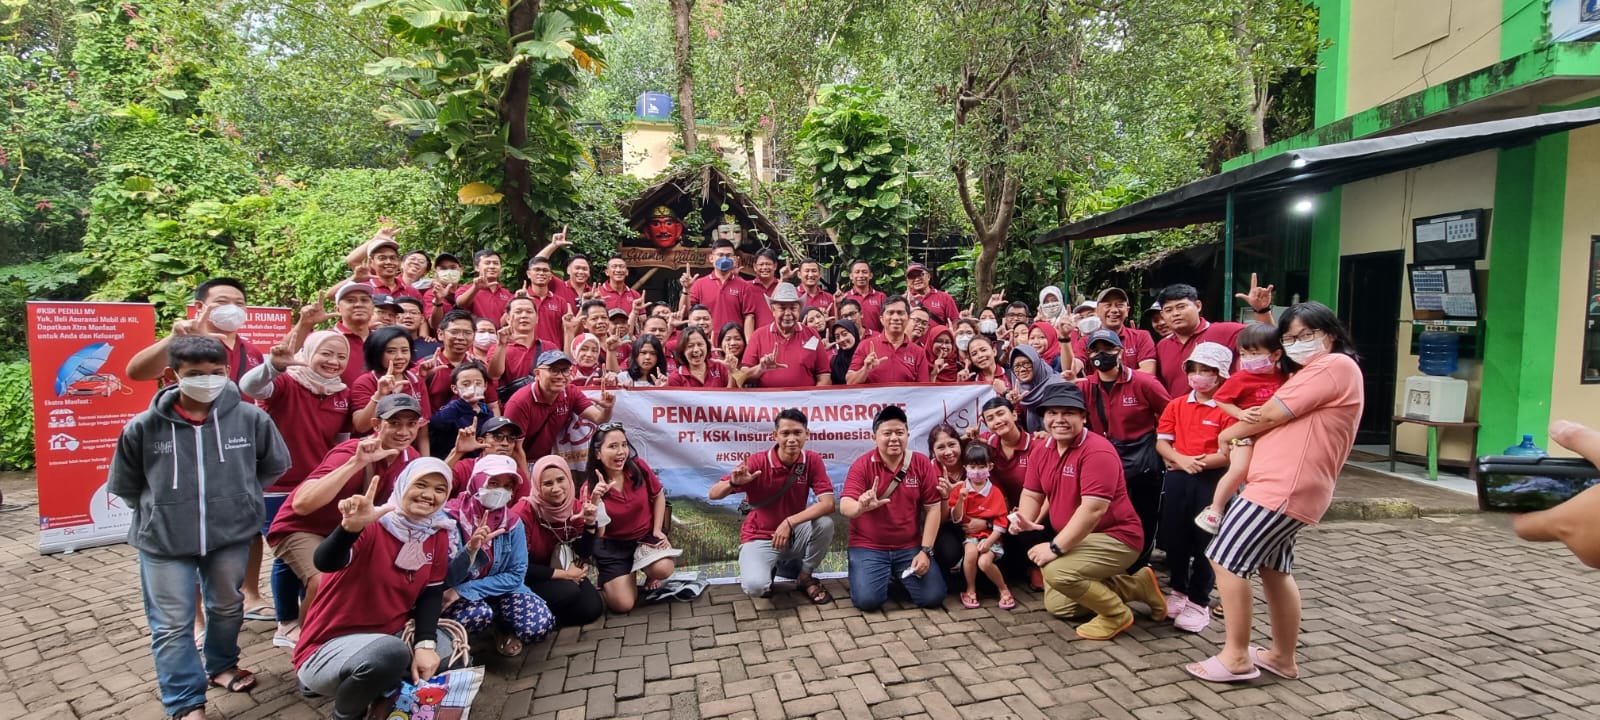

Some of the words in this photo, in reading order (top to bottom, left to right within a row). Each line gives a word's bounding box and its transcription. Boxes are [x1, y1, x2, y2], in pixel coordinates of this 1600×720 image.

[255, 313, 287, 322] RUMAH
[37, 324, 70, 332] Dapatkan
[93, 333, 125, 341] Keluarga!
[652, 405, 786, 424] PENANAMAN
[678, 431, 699, 443] PT.
[704, 430, 731, 442] KSK
[734, 429, 775, 442] Insura
[806, 427, 871, 441] ndonesia
[906, 475, 920, 484] ksk
